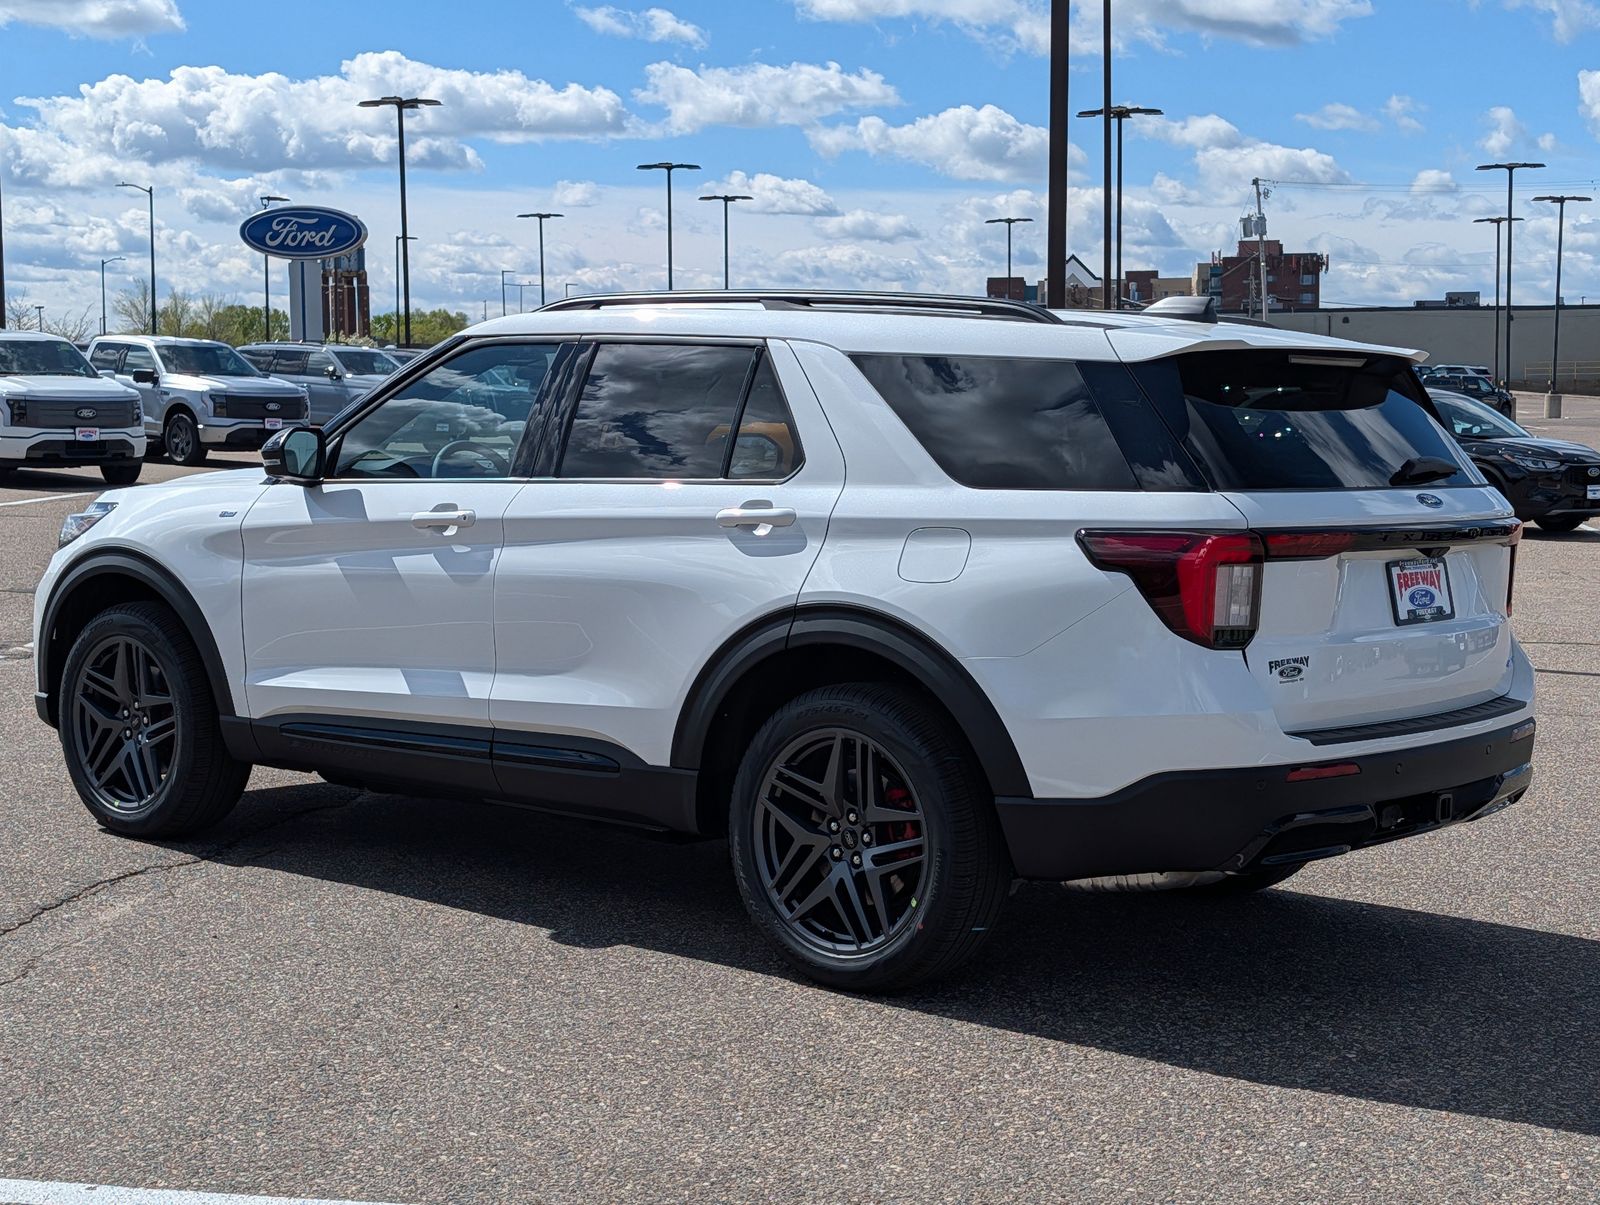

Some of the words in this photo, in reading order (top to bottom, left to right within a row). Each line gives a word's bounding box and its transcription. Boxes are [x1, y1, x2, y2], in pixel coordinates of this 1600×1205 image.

[265, 216, 337, 247] Ford
[1396, 569, 1443, 602] FREEWAY
[1413, 590, 1431, 605] Ford
[1268, 655, 1310, 675] FREEWAY
